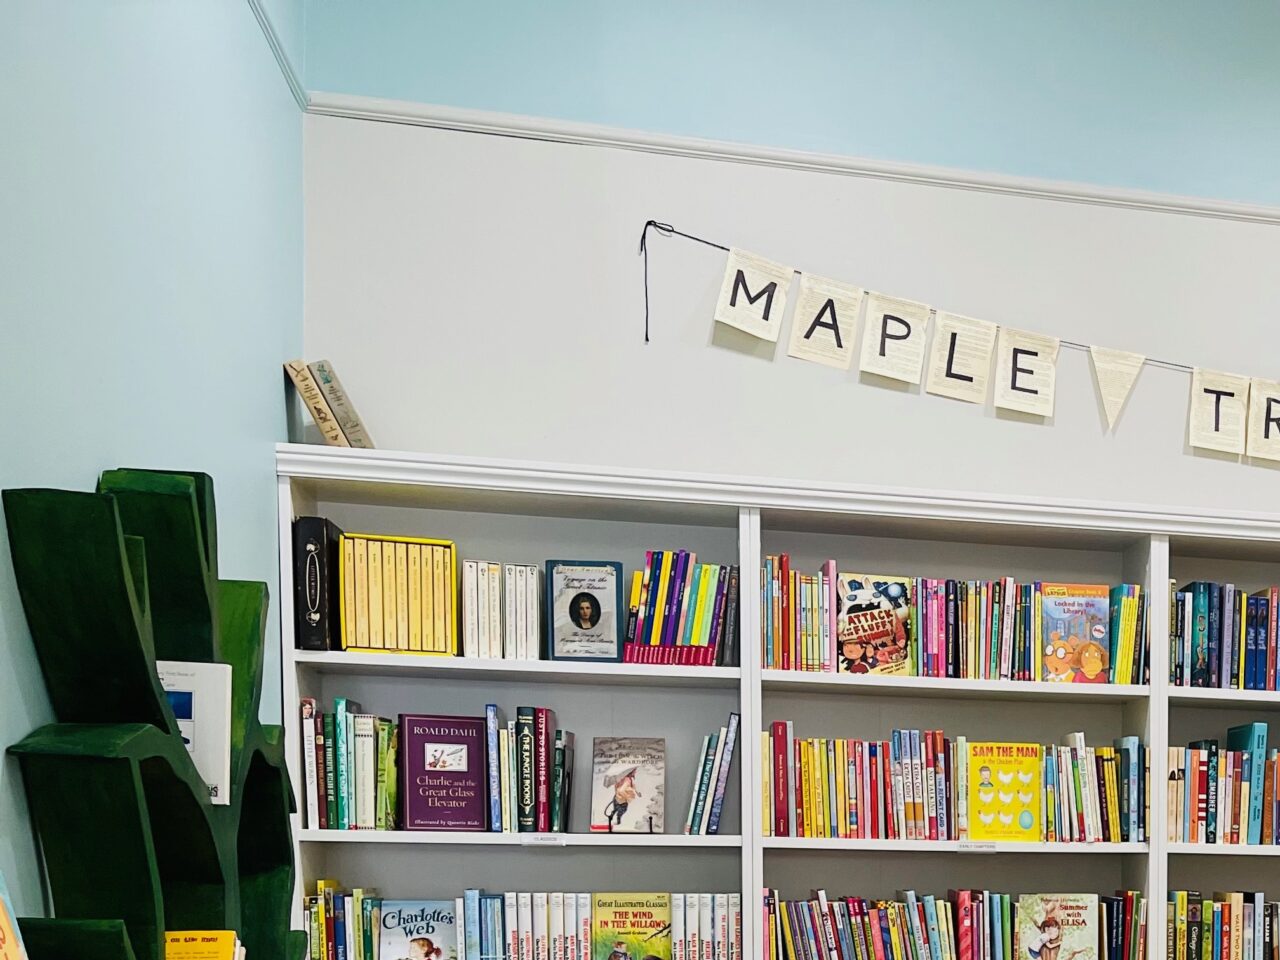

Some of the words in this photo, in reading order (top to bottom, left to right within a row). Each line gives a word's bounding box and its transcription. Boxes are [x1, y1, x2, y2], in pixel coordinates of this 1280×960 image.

[729, 269, 1038, 395] MAPLE
[1084, 600, 1095, 608] the
[848, 609, 894, 626] ATTACK
[413, 726, 450, 736] ROALD
[450, 728, 478, 737] DAHL
[973, 746, 993, 757] SAM
[996, 746, 1014, 757] THE
[1016, 747, 1037, 758] MAN
[416, 775, 452, 786] Charlie
[419, 786, 447, 797] Great
[449, 787, 476, 798] Glass
[428, 797, 468, 808] Elevator
[382, 907, 455, 929] Charlotte's
[613, 911, 630, 919] THE
[632, 911, 653, 919] WIND
[600, 920, 610, 928] IN
[611, 920, 629, 928] THE
[630, 920, 666, 929] WILLOWS
[1061, 919, 1087, 927] ELISA
[402, 921, 436, 938] Web
